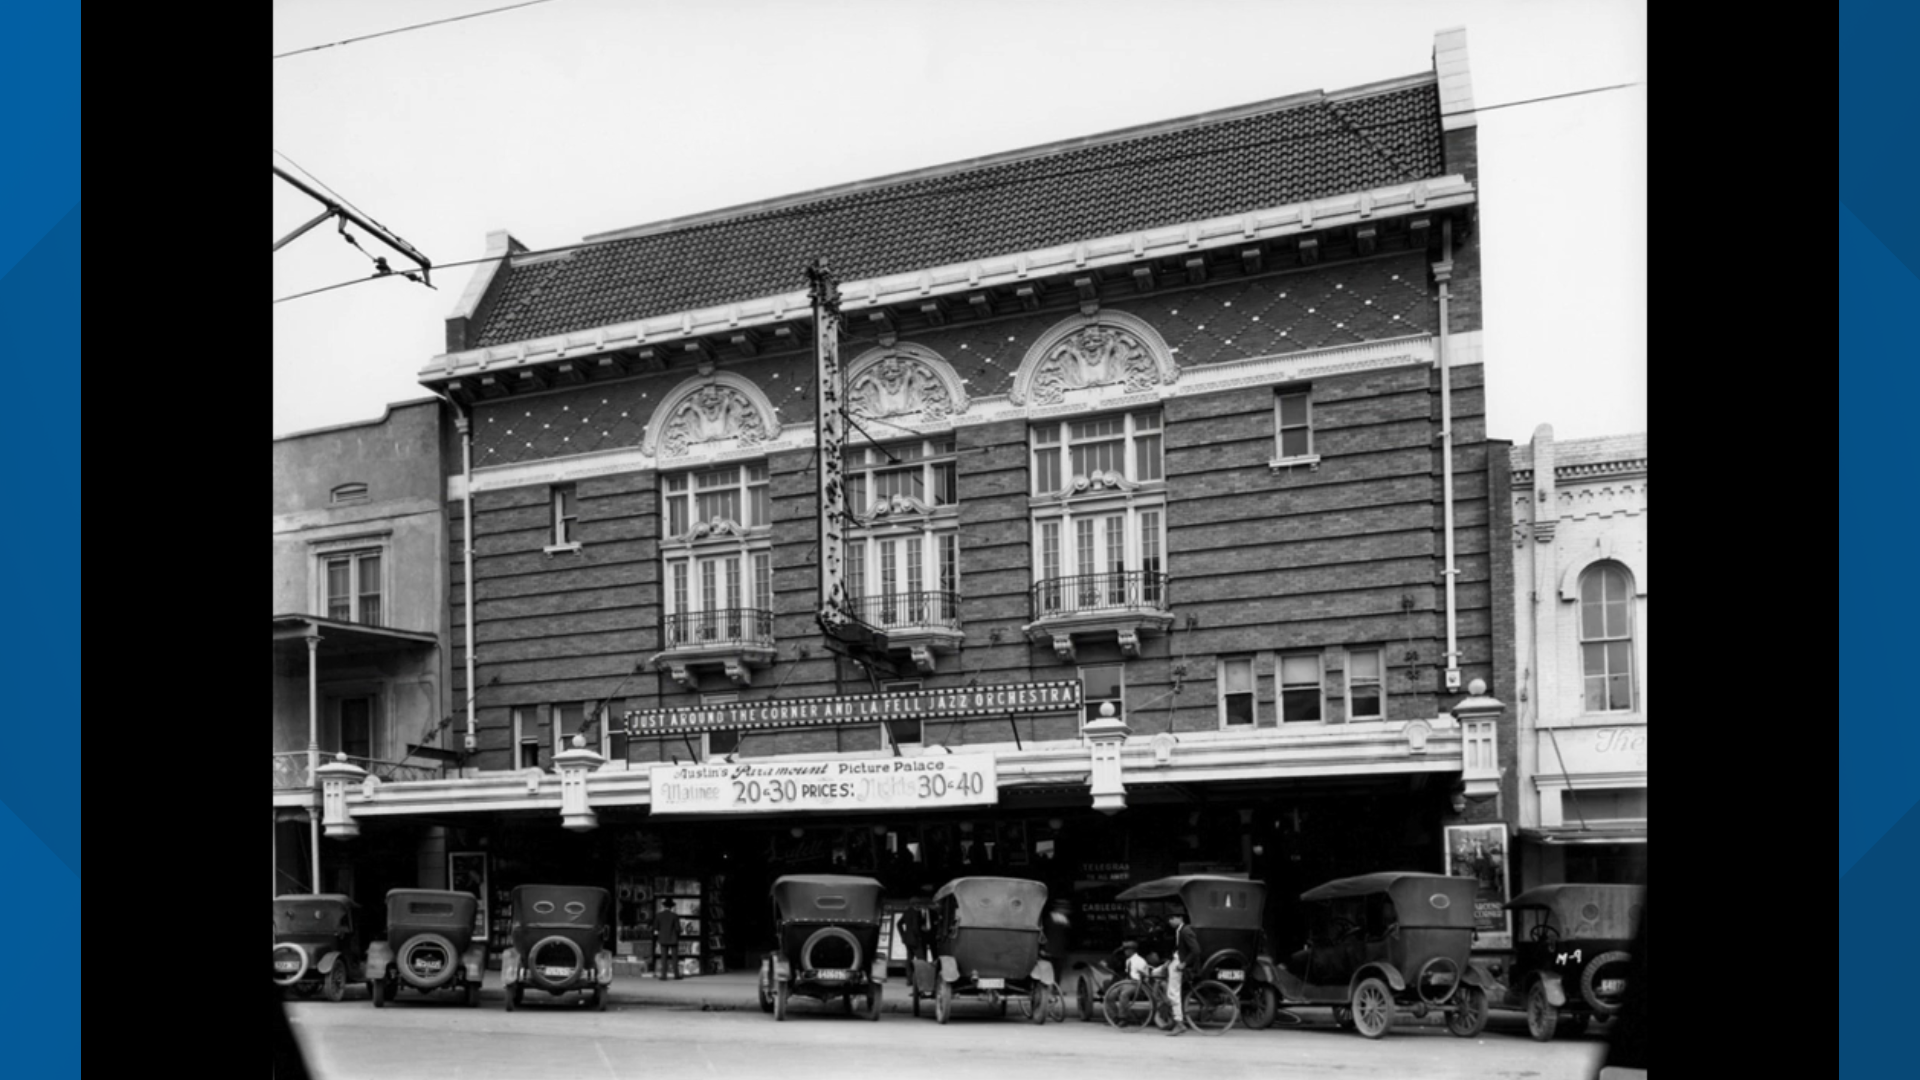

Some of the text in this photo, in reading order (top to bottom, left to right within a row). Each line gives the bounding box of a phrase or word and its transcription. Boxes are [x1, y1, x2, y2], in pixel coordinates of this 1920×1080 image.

[632, 687, 1072, 730] JUST AROUND THE CORNER AND LA FELL JAZZ ORCHESTRA
[1595, 727, 1645, 753] The
[673, 760, 945, 780] Austin's Paramount Picture Palace
[661, 782, 720, 804] Matinee
